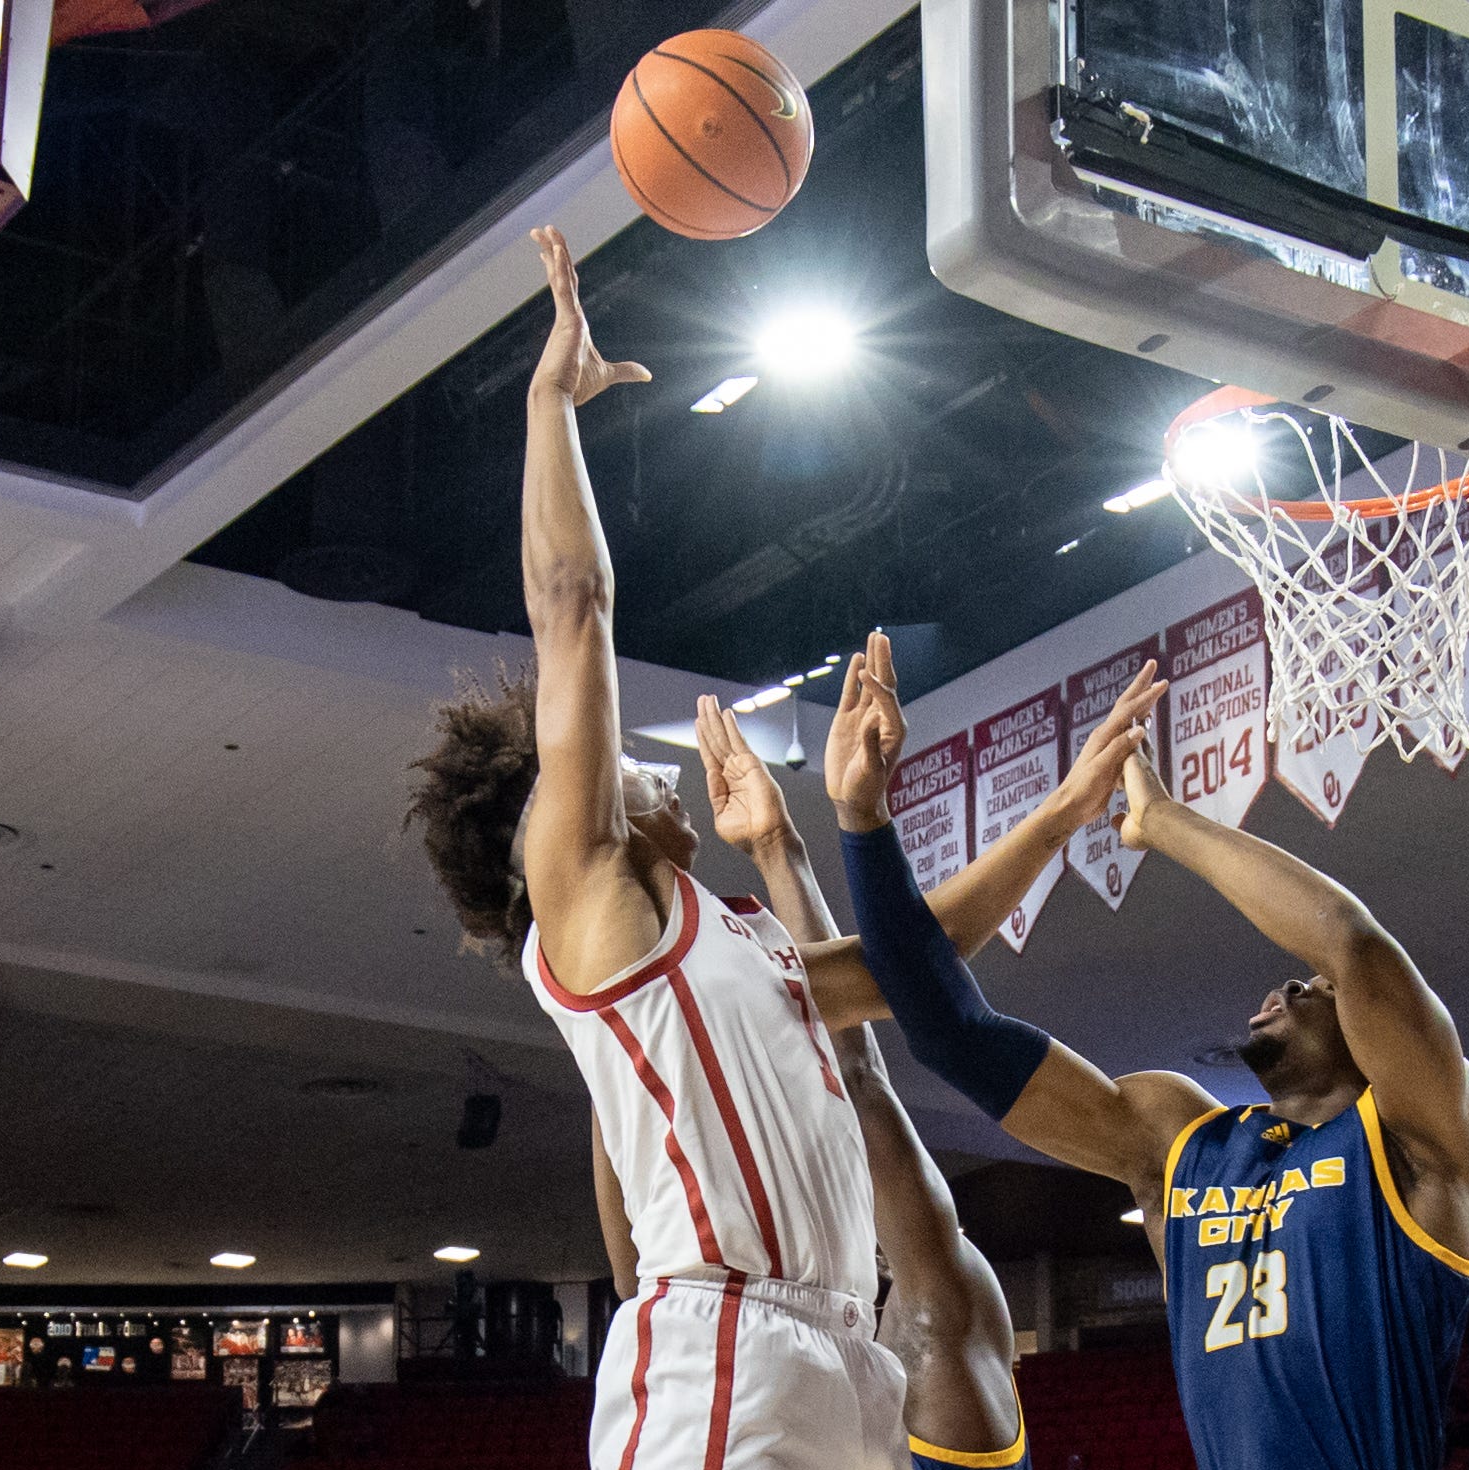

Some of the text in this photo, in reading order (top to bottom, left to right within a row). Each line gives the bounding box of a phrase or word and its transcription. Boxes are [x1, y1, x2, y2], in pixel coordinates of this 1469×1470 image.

[1171, 616, 1261, 677] GYMNASTICS
[1184, 601, 1250, 648] WOMEN'S
[1179, 663, 1255, 716] NATIONAL
[1175, 687, 1262, 745] CHAMPIONS
[992, 756, 1044, 793] REGIONAL
[1181, 726, 1253, 803] 2014
[902, 800, 950, 836] REGIONAL
[986, 774, 1050, 816] CHAMPIONS
[902, 816, 954, 854] HAMPIONS
[1204, 1249, 1288, 1353] 23
